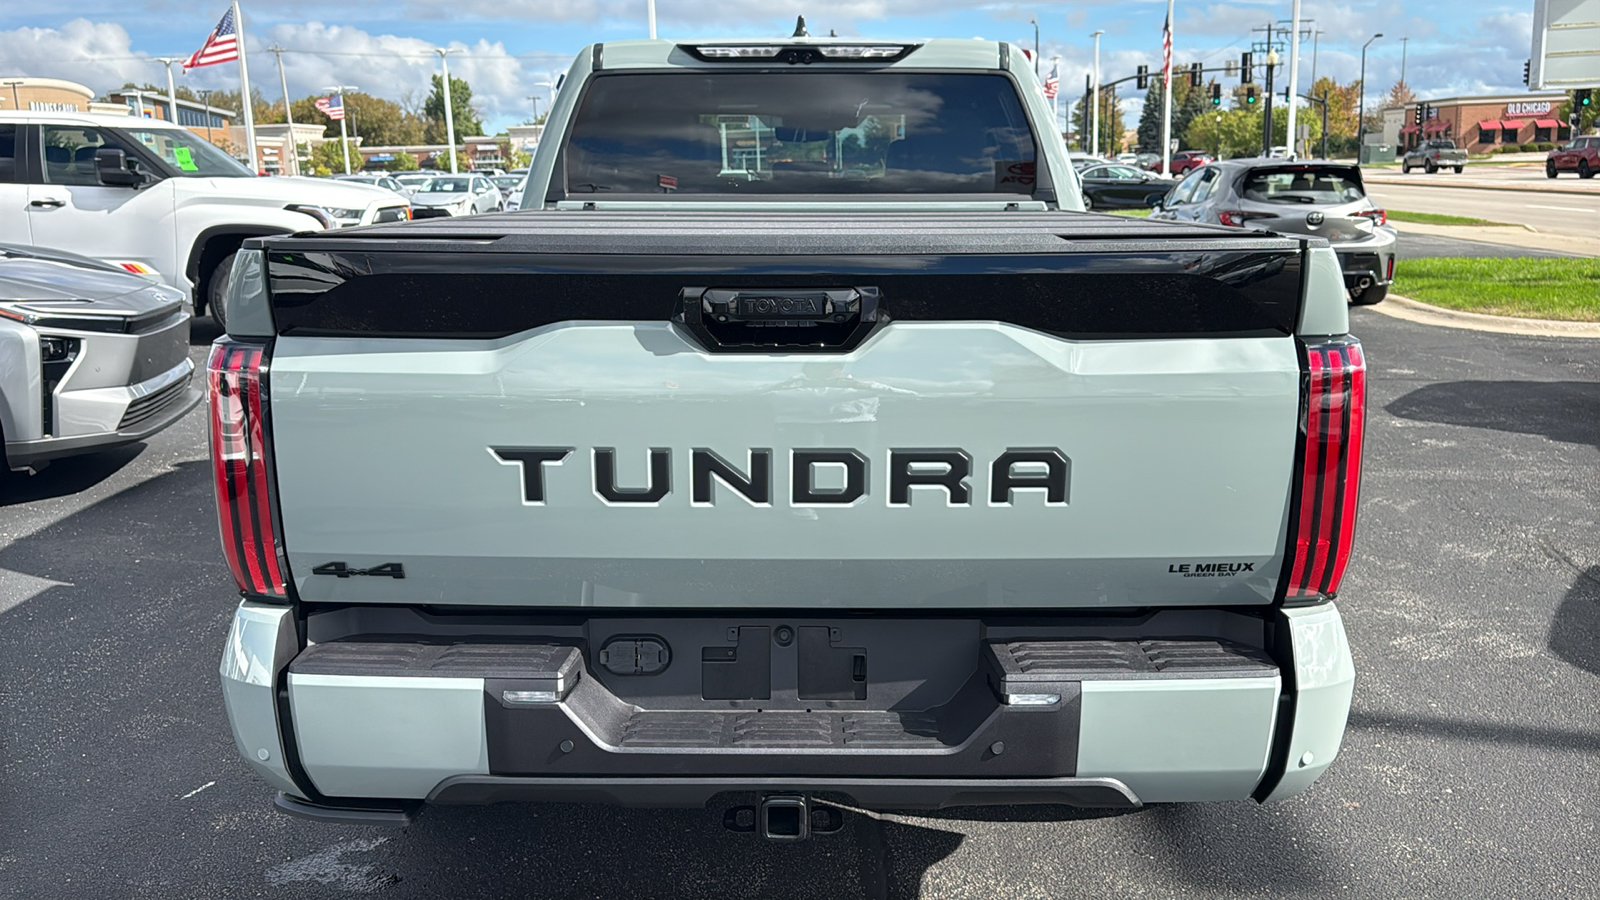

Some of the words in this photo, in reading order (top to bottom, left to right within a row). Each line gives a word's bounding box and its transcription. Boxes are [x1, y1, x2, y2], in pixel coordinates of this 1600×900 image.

[1507, 103, 1520, 114] OLD
[1522, 102, 1551, 114] CHICAGO
[744, 298, 817, 313] TOYOTA
[487, 445, 1072, 507] TUNDRA
[1168, 564, 1191, 573] LE
[1195, 562, 1254, 573] MIEUX
